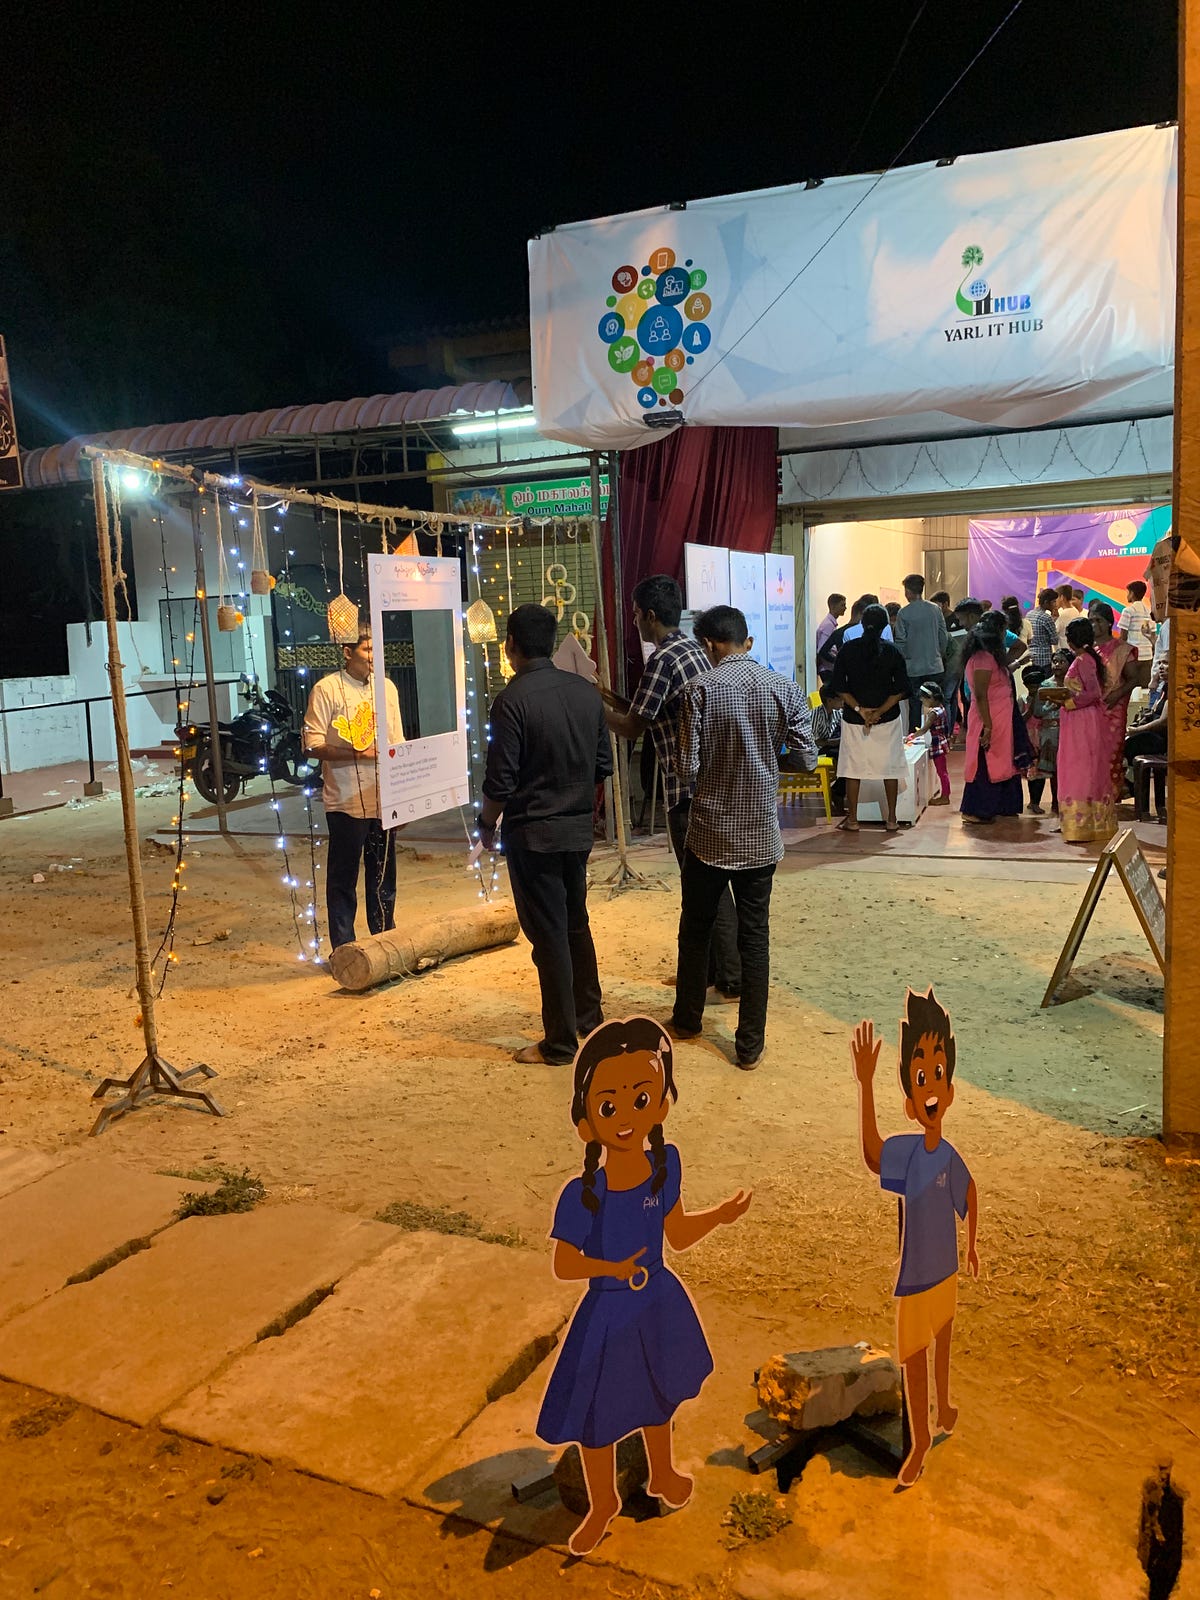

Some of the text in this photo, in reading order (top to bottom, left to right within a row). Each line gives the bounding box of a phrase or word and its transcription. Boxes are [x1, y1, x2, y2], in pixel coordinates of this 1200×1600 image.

[944, 318, 1044, 342] YARL IT HUB
[527, 506, 551, 515] Oum
[1098, 546, 1148, 557] YARL IT HUB
